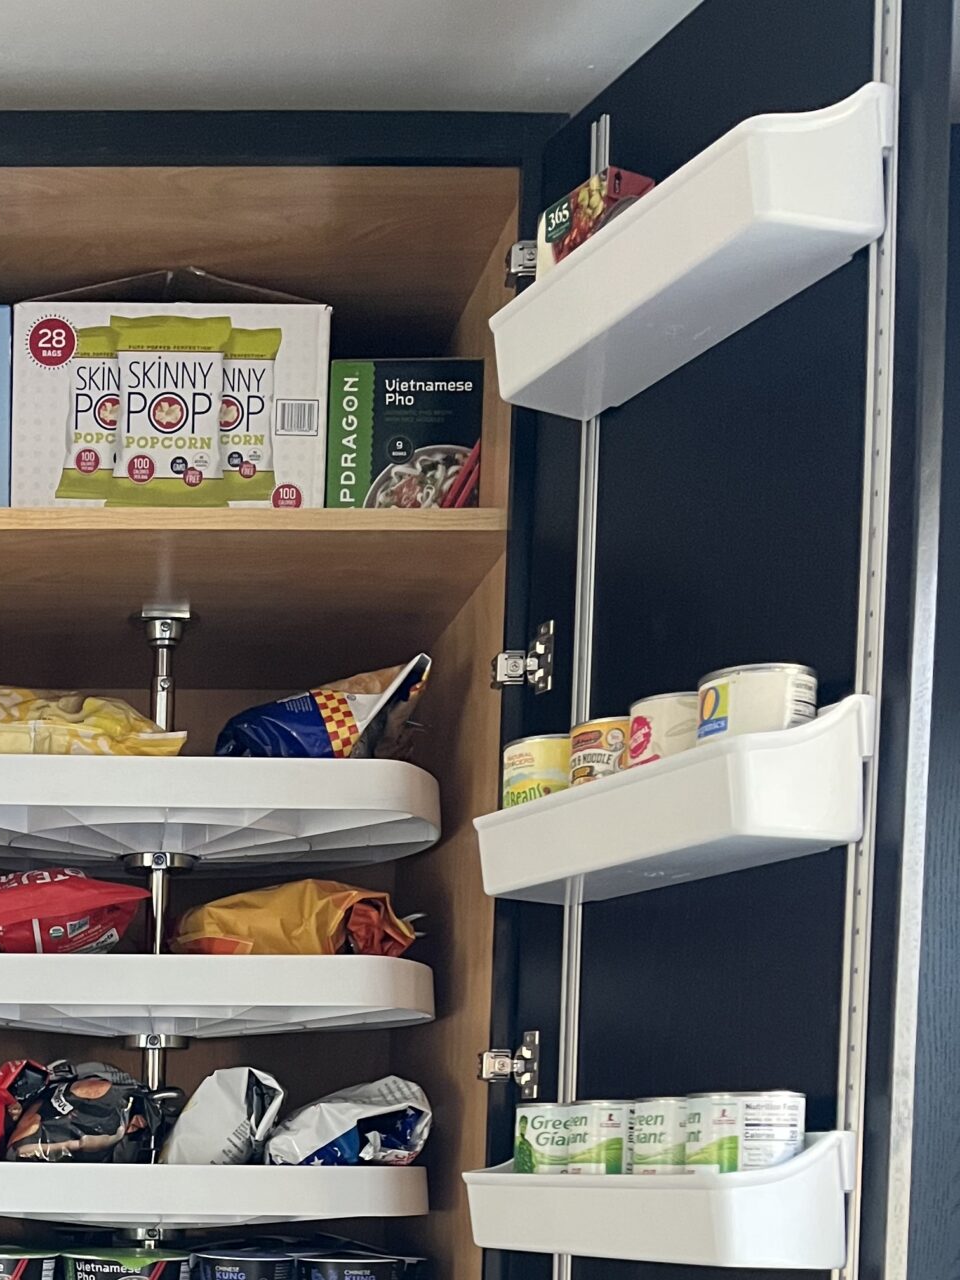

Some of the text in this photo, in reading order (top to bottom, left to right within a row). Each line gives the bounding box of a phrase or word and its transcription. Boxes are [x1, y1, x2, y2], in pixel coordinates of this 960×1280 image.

[547, 202, 570, 231] 365
[38, 329, 66, 348] 28
[128, 356, 213, 389] SKINNY
[385, 378, 473, 392] Vietnamese
[385, 393, 414, 405] Pho
[126, 392, 212, 434] POP
[125, 436, 212, 450] POPCORN
[396, 441, 403, 449] 9
[81, 452, 95, 461] 100
[133, 458, 149, 468] 100
[186, 474, 200, 483] FREE
[279, 488, 296, 499] 100
[583, 753, 613, 765] NOODLE
[215, 1272, 246, 1280] KUNG
